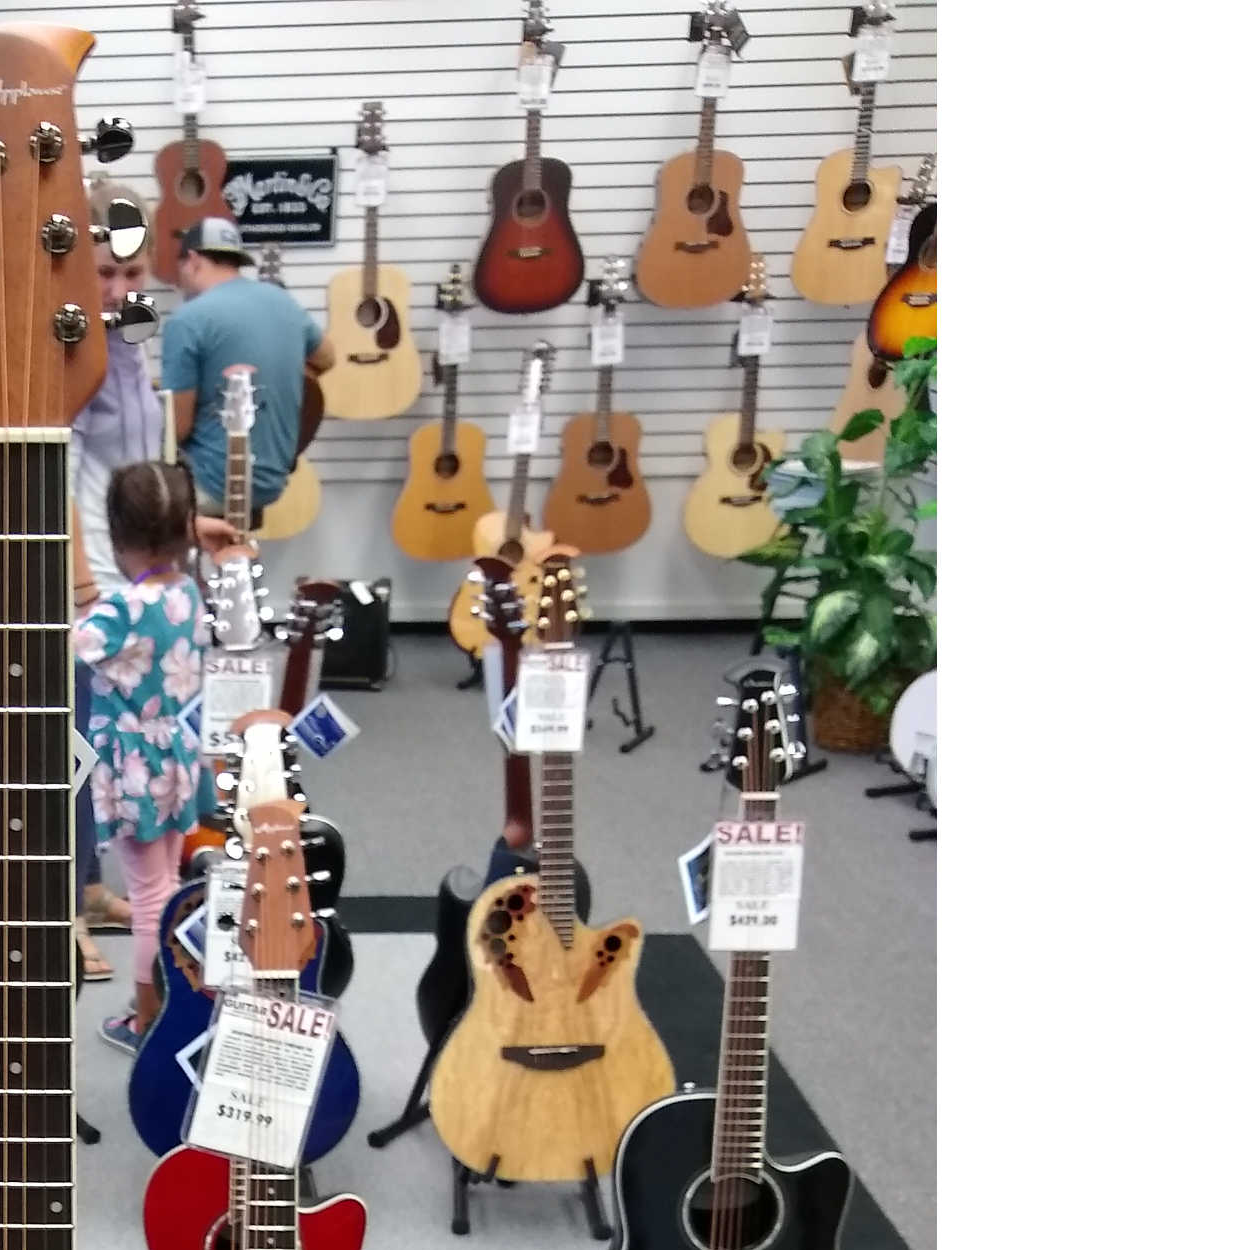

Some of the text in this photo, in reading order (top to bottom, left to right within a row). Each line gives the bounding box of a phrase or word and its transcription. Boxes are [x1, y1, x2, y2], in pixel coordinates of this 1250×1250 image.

[717, 824, 801, 845] SALE!
[266, 1001, 334, 1040] SALE!
[230, 1089, 266, 1108] SALE
[217, 1103, 274, 1129] $319.99
